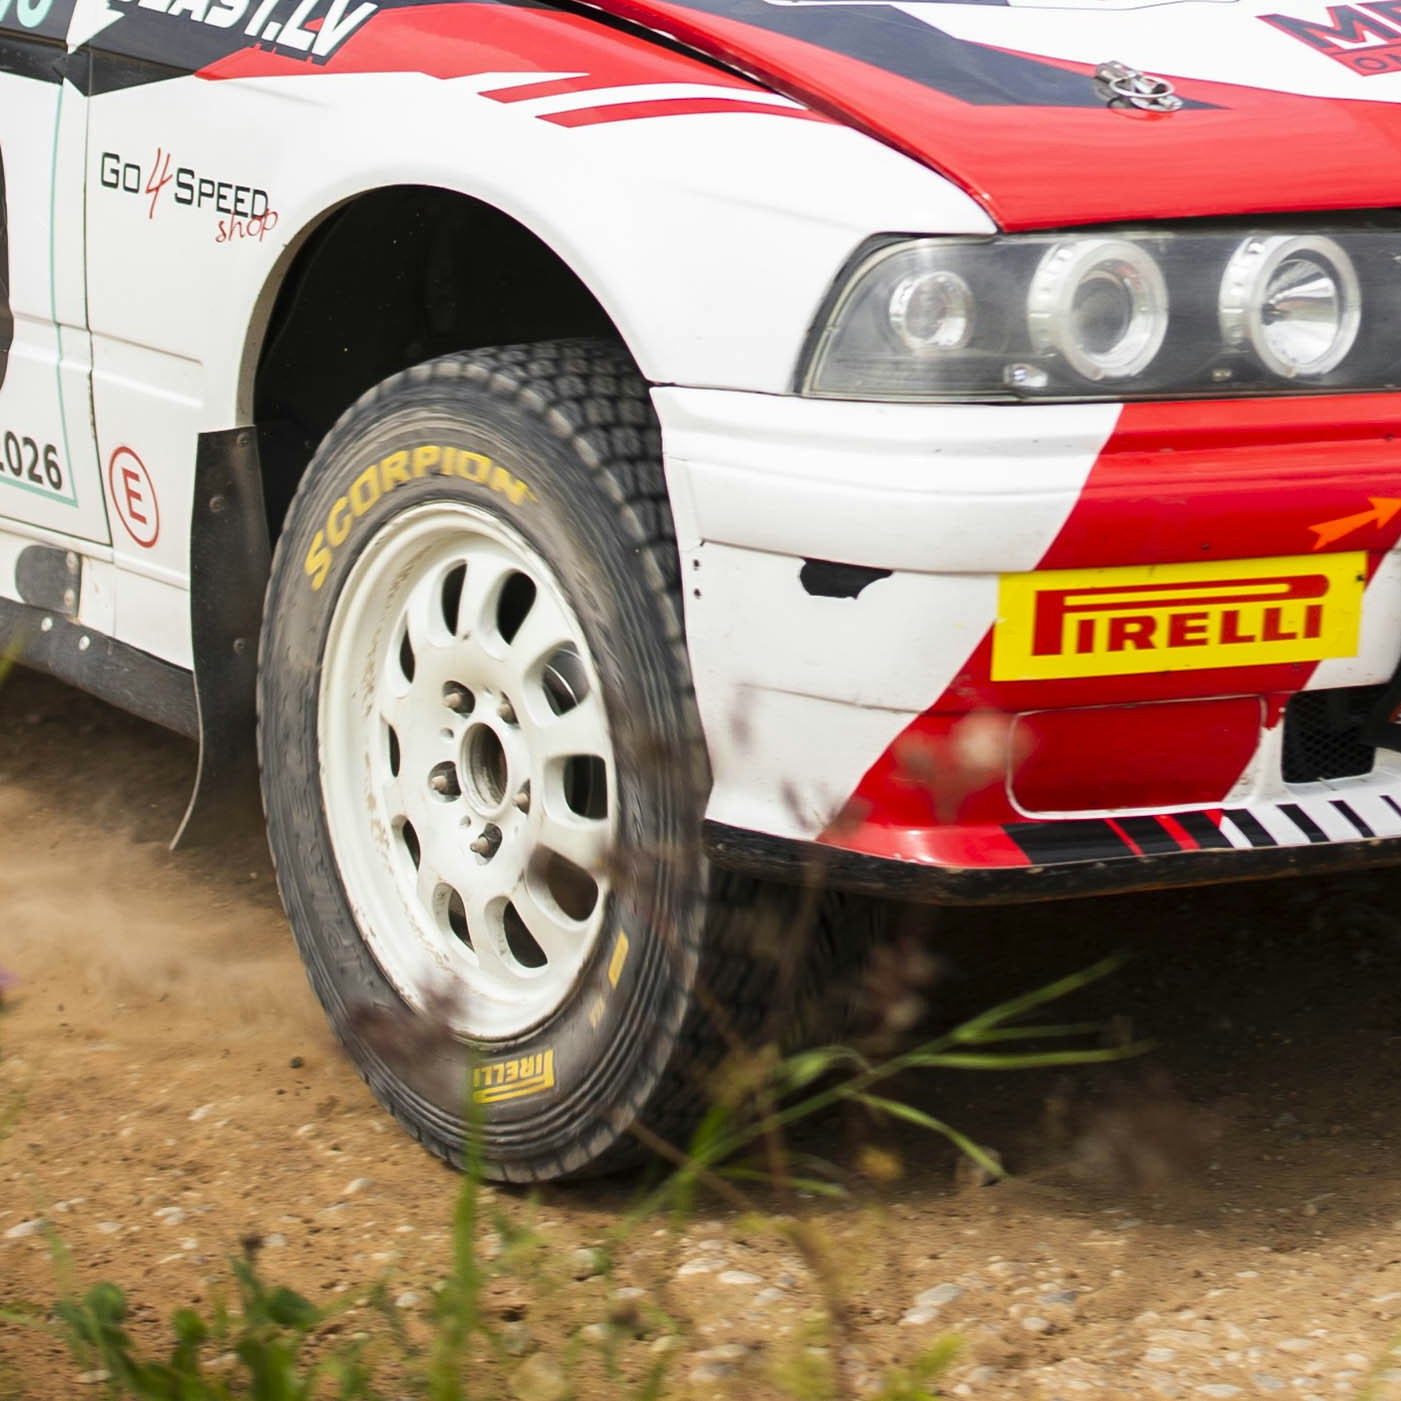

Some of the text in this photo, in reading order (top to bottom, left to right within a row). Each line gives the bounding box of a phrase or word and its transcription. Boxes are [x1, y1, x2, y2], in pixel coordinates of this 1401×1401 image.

[215, 208, 279, 244] shop
[303, 445, 530, 592] SCORPION
[1031, 574, 1330, 656] PIRELLI
[472, 1050, 555, 1104] PIRELLI
